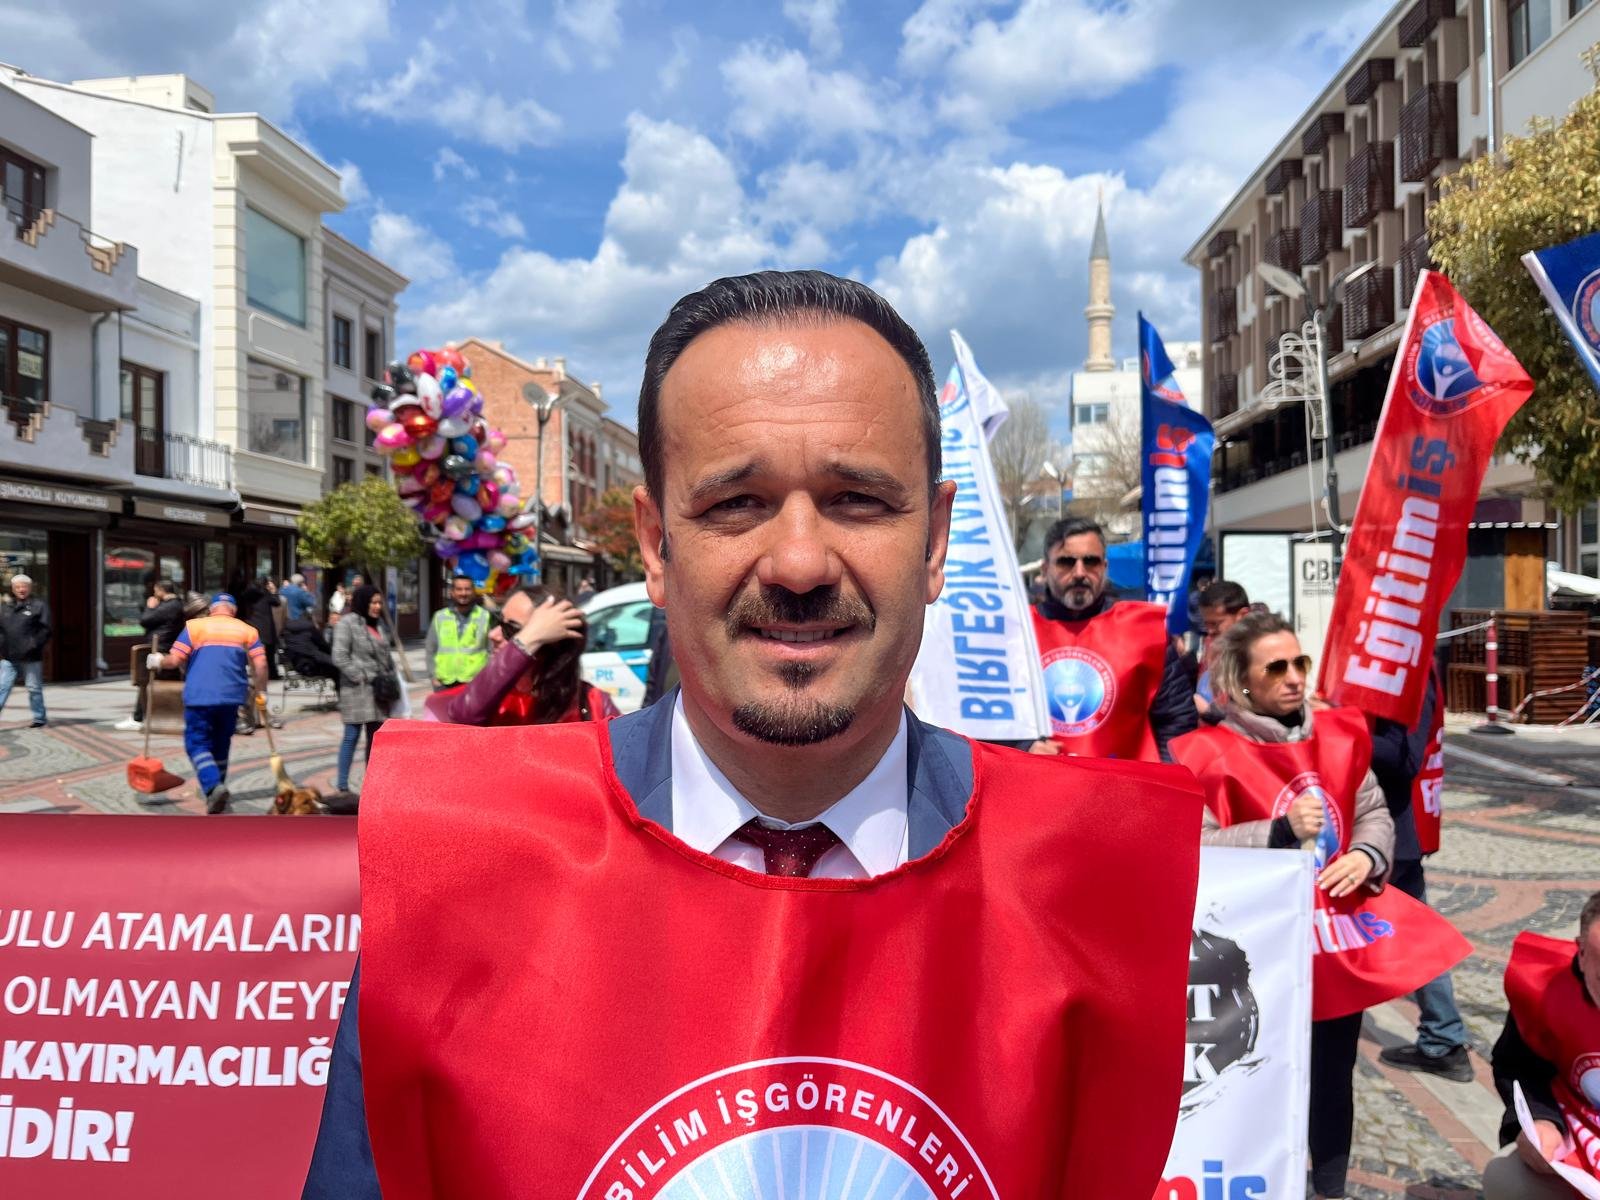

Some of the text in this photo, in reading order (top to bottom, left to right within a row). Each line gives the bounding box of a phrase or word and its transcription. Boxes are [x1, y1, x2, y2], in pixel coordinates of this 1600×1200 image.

[4, 976, 221, 1020] OLMAYAN
[1, 1037, 332, 1087] KAYIRMACILIĞ
[603, 1074, 973, 1200] BİLİM İŞGÖRENLERİ
